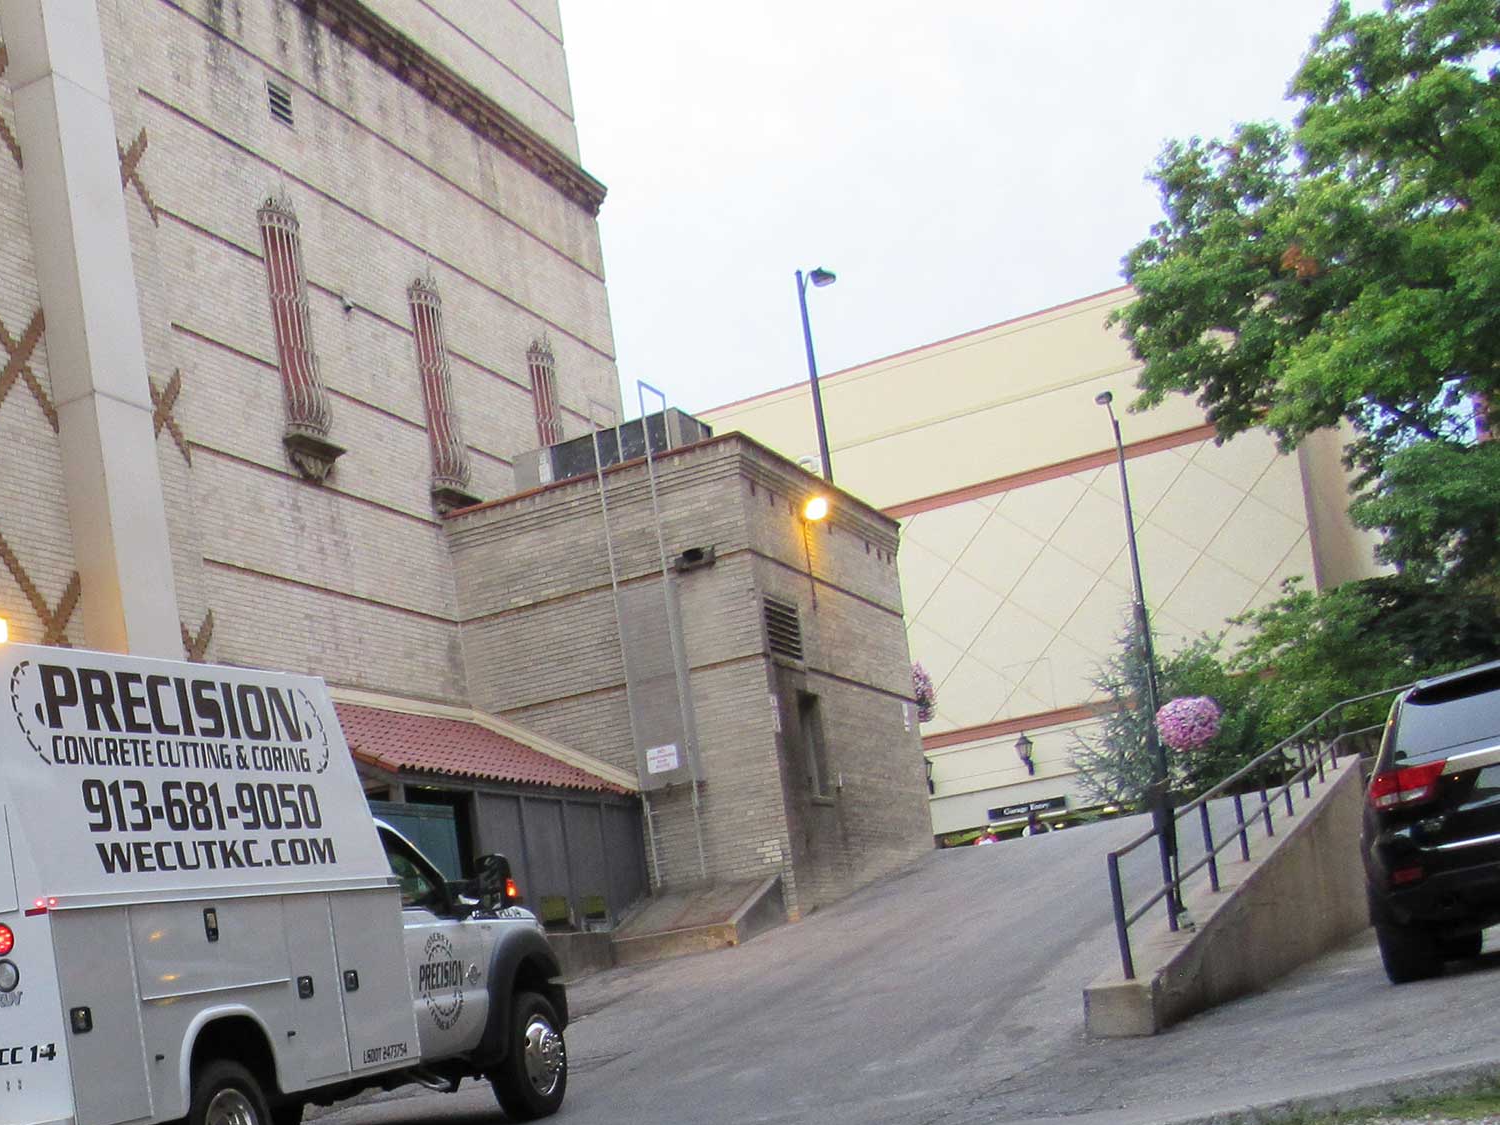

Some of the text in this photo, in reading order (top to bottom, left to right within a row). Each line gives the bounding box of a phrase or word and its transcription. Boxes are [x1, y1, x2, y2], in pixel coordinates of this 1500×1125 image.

[38, 664, 302, 743] PRECISION
[51, 735, 312, 773] CONCRETE CUTTING & CORING
[81, 779, 322, 832] 913-681-9050
[95, 837, 338, 874] WECUTKC.COM
[419, 960, 464, 992] PRECISION
[30, 1043, 57, 1063] 14
